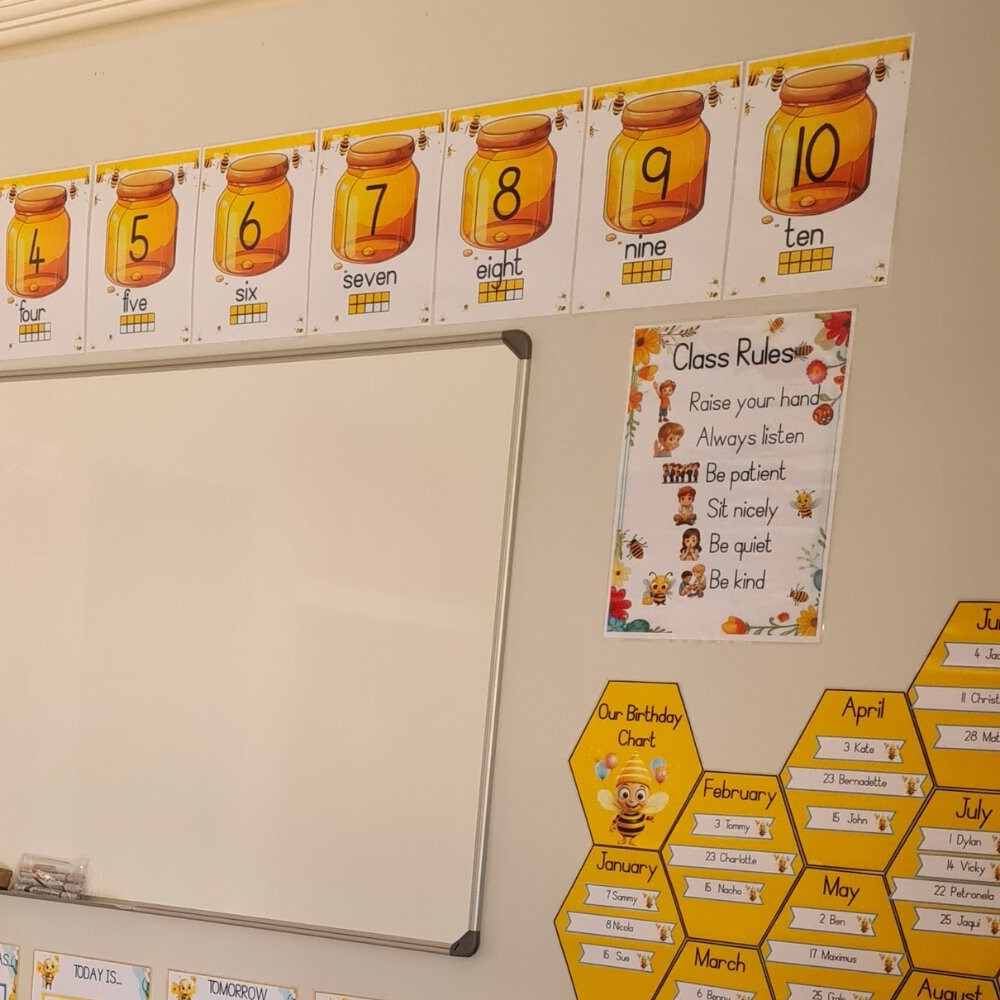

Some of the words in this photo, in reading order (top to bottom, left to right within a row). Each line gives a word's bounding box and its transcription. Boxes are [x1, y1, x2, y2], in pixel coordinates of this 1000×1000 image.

[791, 123, 841, 192] 10
[642, 146, 671, 200] 9
[493, 166, 522, 221] 8
[366, 184, 387, 236] 7
[240, 201, 261, 250] 6
[784, 222, 824, 248] ten
[130, 214, 148, 262] 5
[625, 235, 666, 259] nine
[29, 229, 45, 274] 4
[343, 267, 396, 289] seven
[474, 252, 524, 288] eight
[123, 288, 147, 312] five
[236, 281, 257, 302] six
[19, 299, 46, 322] four
[673, 342, 729, 370] Class
[737, 336, 794, 366] Rules
[690, 392, 731, 412] Raise
[735, 390, 775, 418] your
[780, 386, 821, 407] hand
[696, 426, 757, 454] Always
[762, 424, 804, 444] listen
[706, 462, 726, 482] Be
[730, 460, 786, 490] patient
[707, 498, 728, 518] Sit
[734, 497, 778, 526] nicely
[710, 533, 728, 553] Be
[734, 532, 772, 561] quiet
[710, 569, 729, 589] Be
[734, 569, 766, 589] kind
[598, 703, 623, 720] Our
[626, 704, 682, 730] Birthday
[842, 696, 885, 726] April
[618, 729, 656, 748] Chart
[854, 742, 874, 754] Kate
[823, 773, 834, 783] 23
[839, 774, 887, 787] Bernadette
[704, 778, 777, 810] February
[848, 813, 868, 824] John
[956, 797, 993, 829] July
[714, 819, 720, 828] 3
[725, 819, 750, 834] Tommy
[957, 834, 981, 849] Dylan
[596, 852, 657, 883] January
[706, 851, 716, 861] 23
[720, 852, 757, 864] Charlotte
[960, 860, 985, 877] Vicky
[612, 890, 638, 906] Sammy
[718, 884, 742, 895] Nacho
[823, 875, 860, 906] May
[934, 885, 946, 896] 22
[950, 886, 994, 900] Petronela
[613, 920, 634, 932] Nicola
[830, 914, 845, 926] Ben
[940, 914, 951, 925] 25
[957, 915, 981, 931] Jaqui
[616, 951, 630, 962] Sue
[694, 947, 745, 972] March
[822, 950, 856, 963] Maximus
[74, 964, 103, 982] TODAY
[812, 990, 822, 1000] 25
